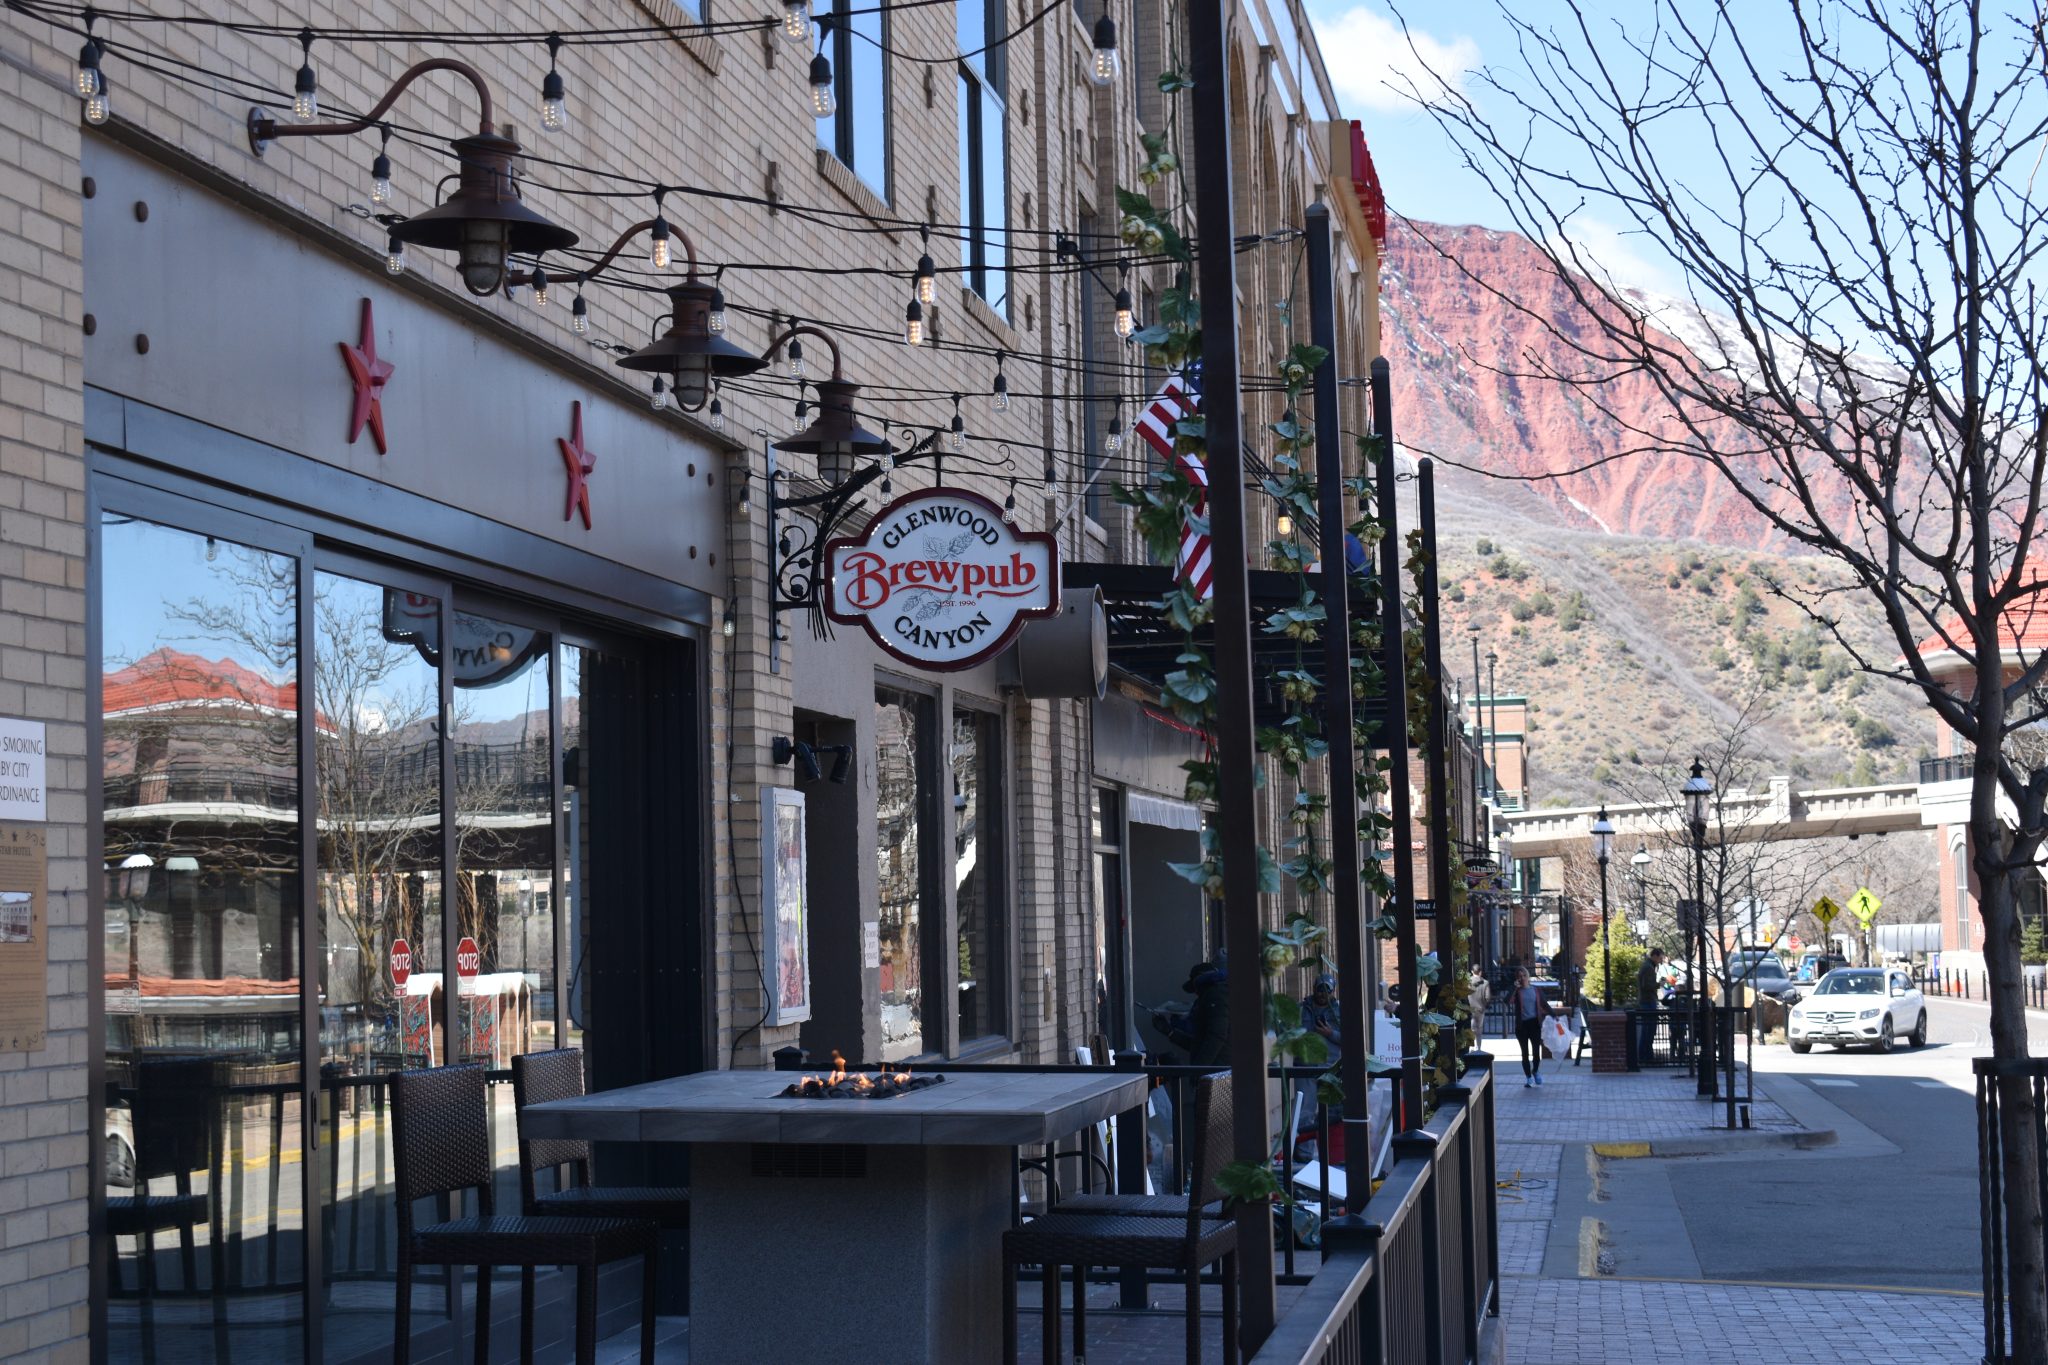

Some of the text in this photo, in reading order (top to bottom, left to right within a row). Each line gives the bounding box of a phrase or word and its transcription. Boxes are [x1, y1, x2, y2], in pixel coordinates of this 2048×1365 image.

[882, 505, 1000, 549] GLENWOOD
[842, 551, 1037, 609] Brewpub
[894, 611, 992, 649] CANYON
[3, 736, 43, 755] SMOKING
[1, 760, 31, 778] BY CITY
[1466, 865, 1497, 873] ullman
